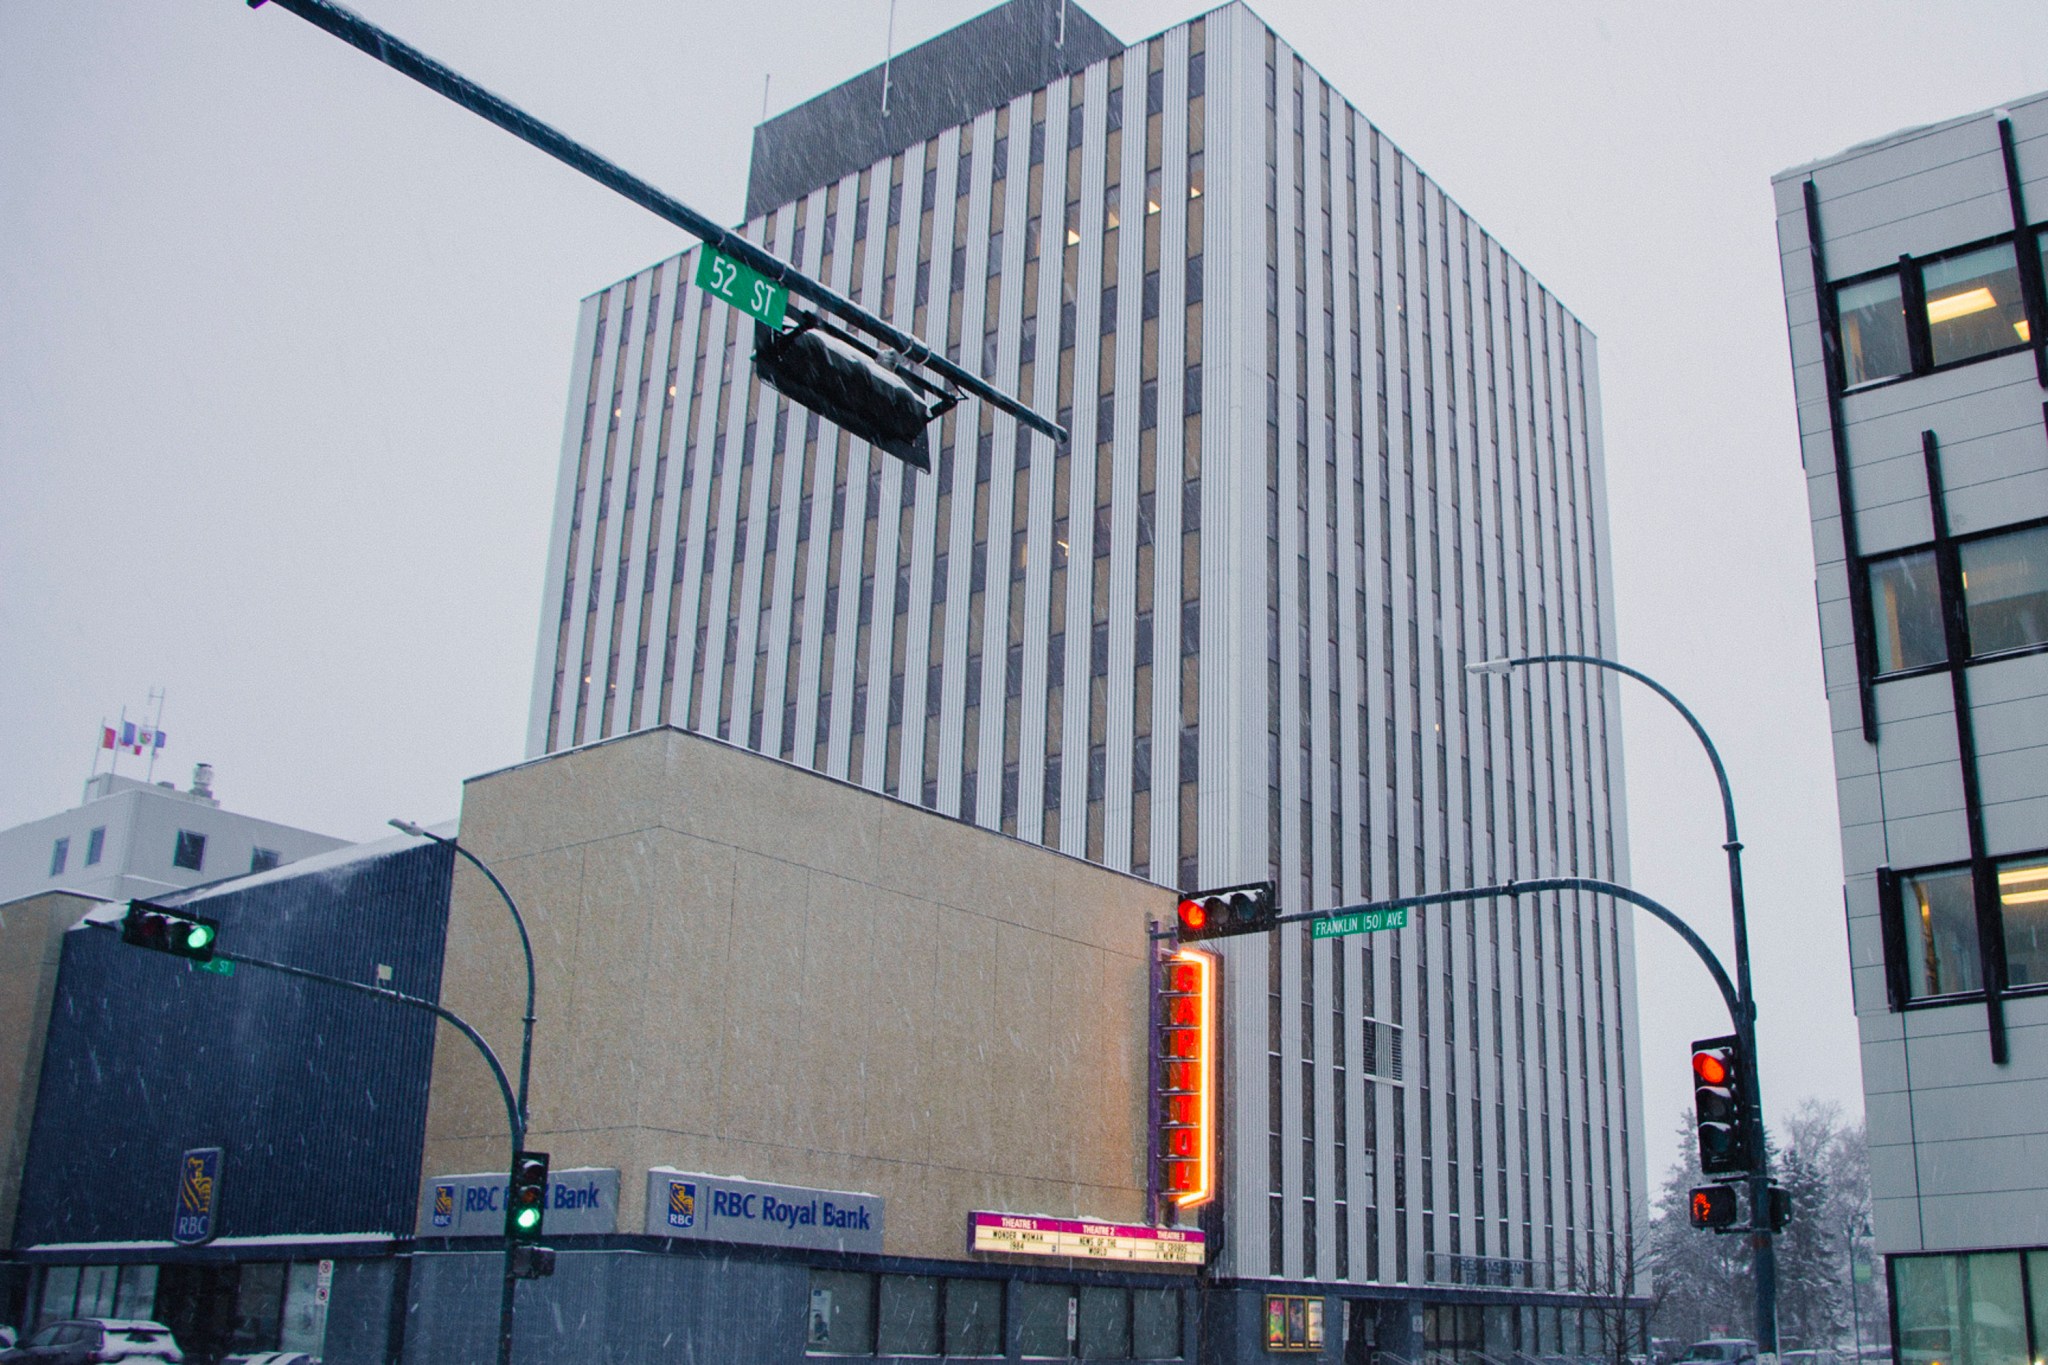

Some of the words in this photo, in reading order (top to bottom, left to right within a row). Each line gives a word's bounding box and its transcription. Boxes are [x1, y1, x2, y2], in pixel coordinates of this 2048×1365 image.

[710, 255, 737, 297] 52
[751, 279, 776, 316] ST
[1315, 917, 1358, 936] FRANKLIN
[1363, 913, 1382, 931] (50)
[1386, 911, 1403, 927] AVE
[1175, 965, 1195, 1191] CAPITOL
[465, 1186, 499, 1212] RBC
[553, 1181, 600, 1209] Bank
[713, 1190, 756, 1219] RBC
[762, 1196, 817, 1230] Royal
[822, 1201, 871, 1230] Bank
[178, 1216, 208, 1235] RBC
[434, 1214, 451, 1226] RBC
[669, 1213, 692, 1226] RBC
[1001, 1217, 1031, 1230] THEATRE
[1032, 1220, 1038, 1230] 1
[993, 1230, 1017, 1239] WONDER
[1022, 1232, 1043, 1241] WOMAN
[1082, 1224, 1110, 1236] THEATRE
[1109, 1226, 1115, 1237] 2
[1156, 1230, 1180, 1241] THEATRE
[1180, 1231, 1186, 1241] 3
